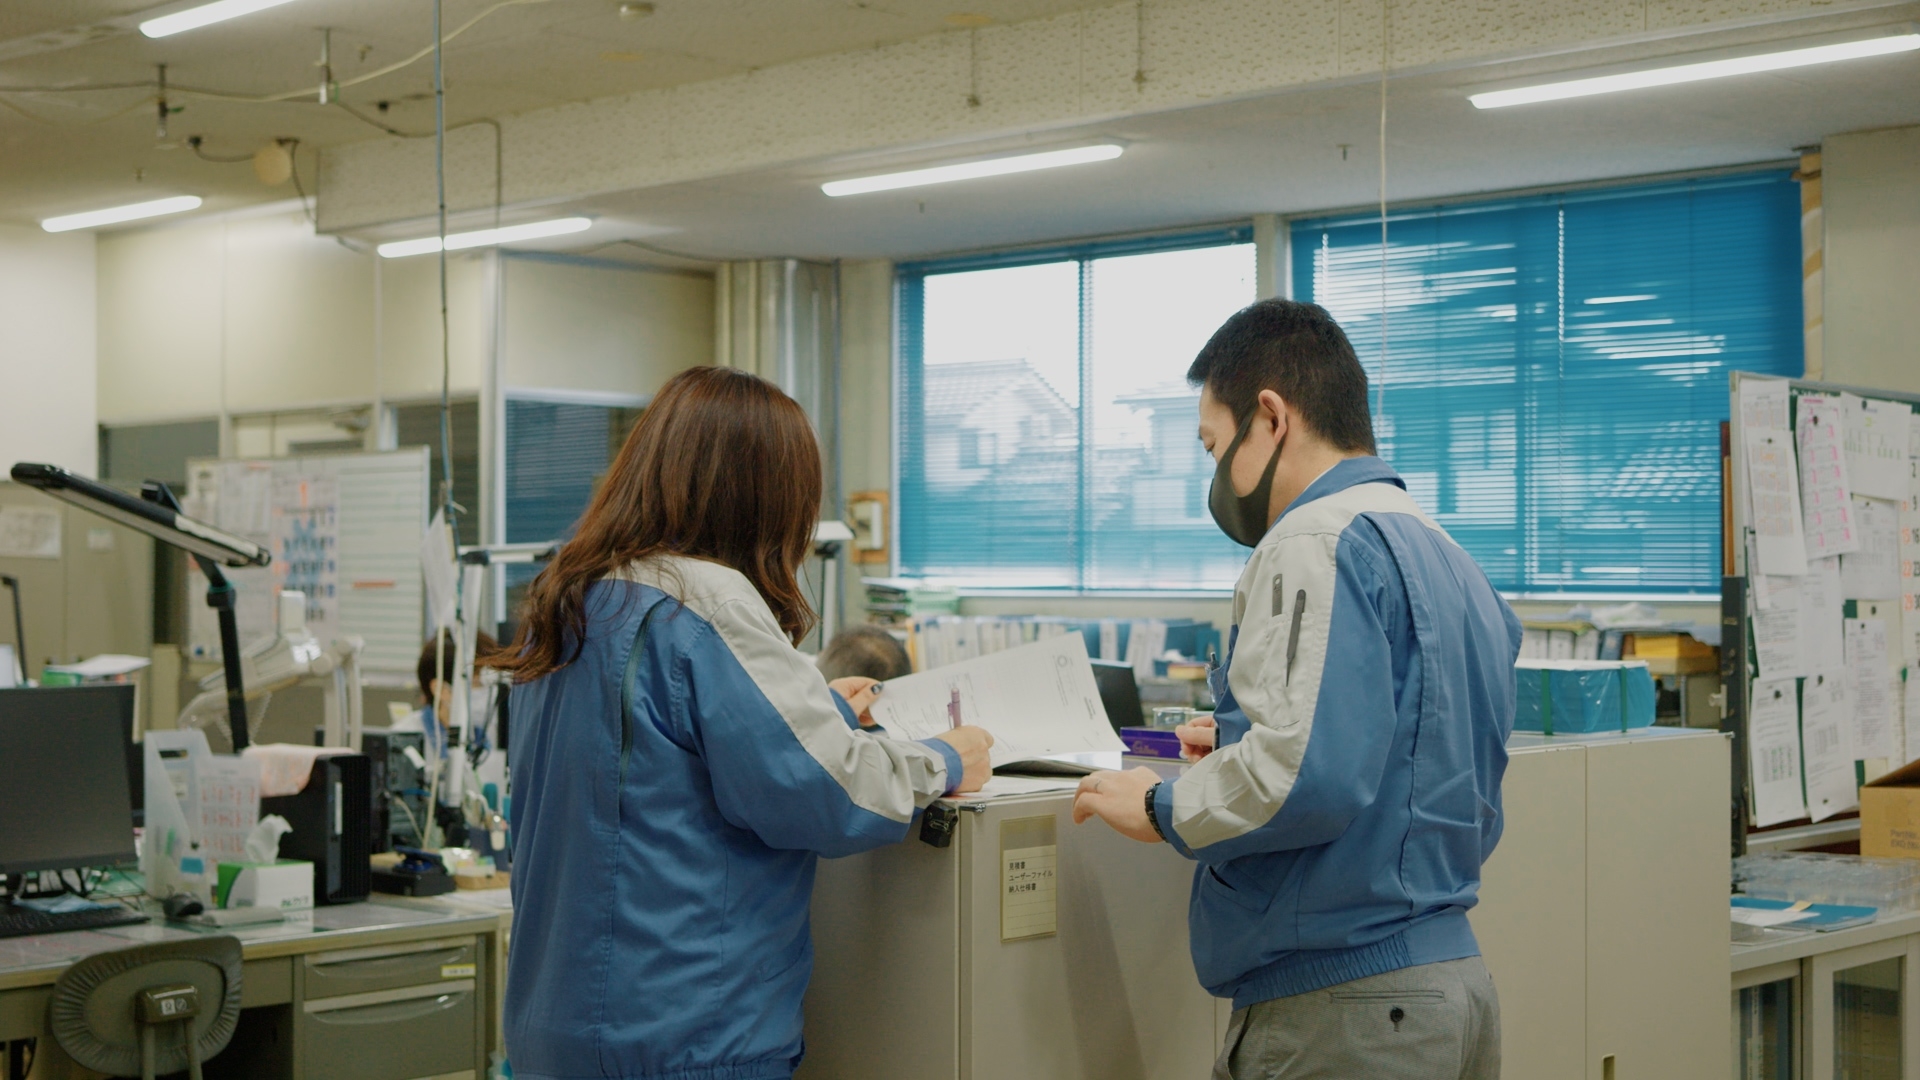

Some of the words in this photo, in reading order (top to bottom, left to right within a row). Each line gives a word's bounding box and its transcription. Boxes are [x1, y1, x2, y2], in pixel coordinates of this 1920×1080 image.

[1009, 870, 1053, 881] ユーザーファイル
